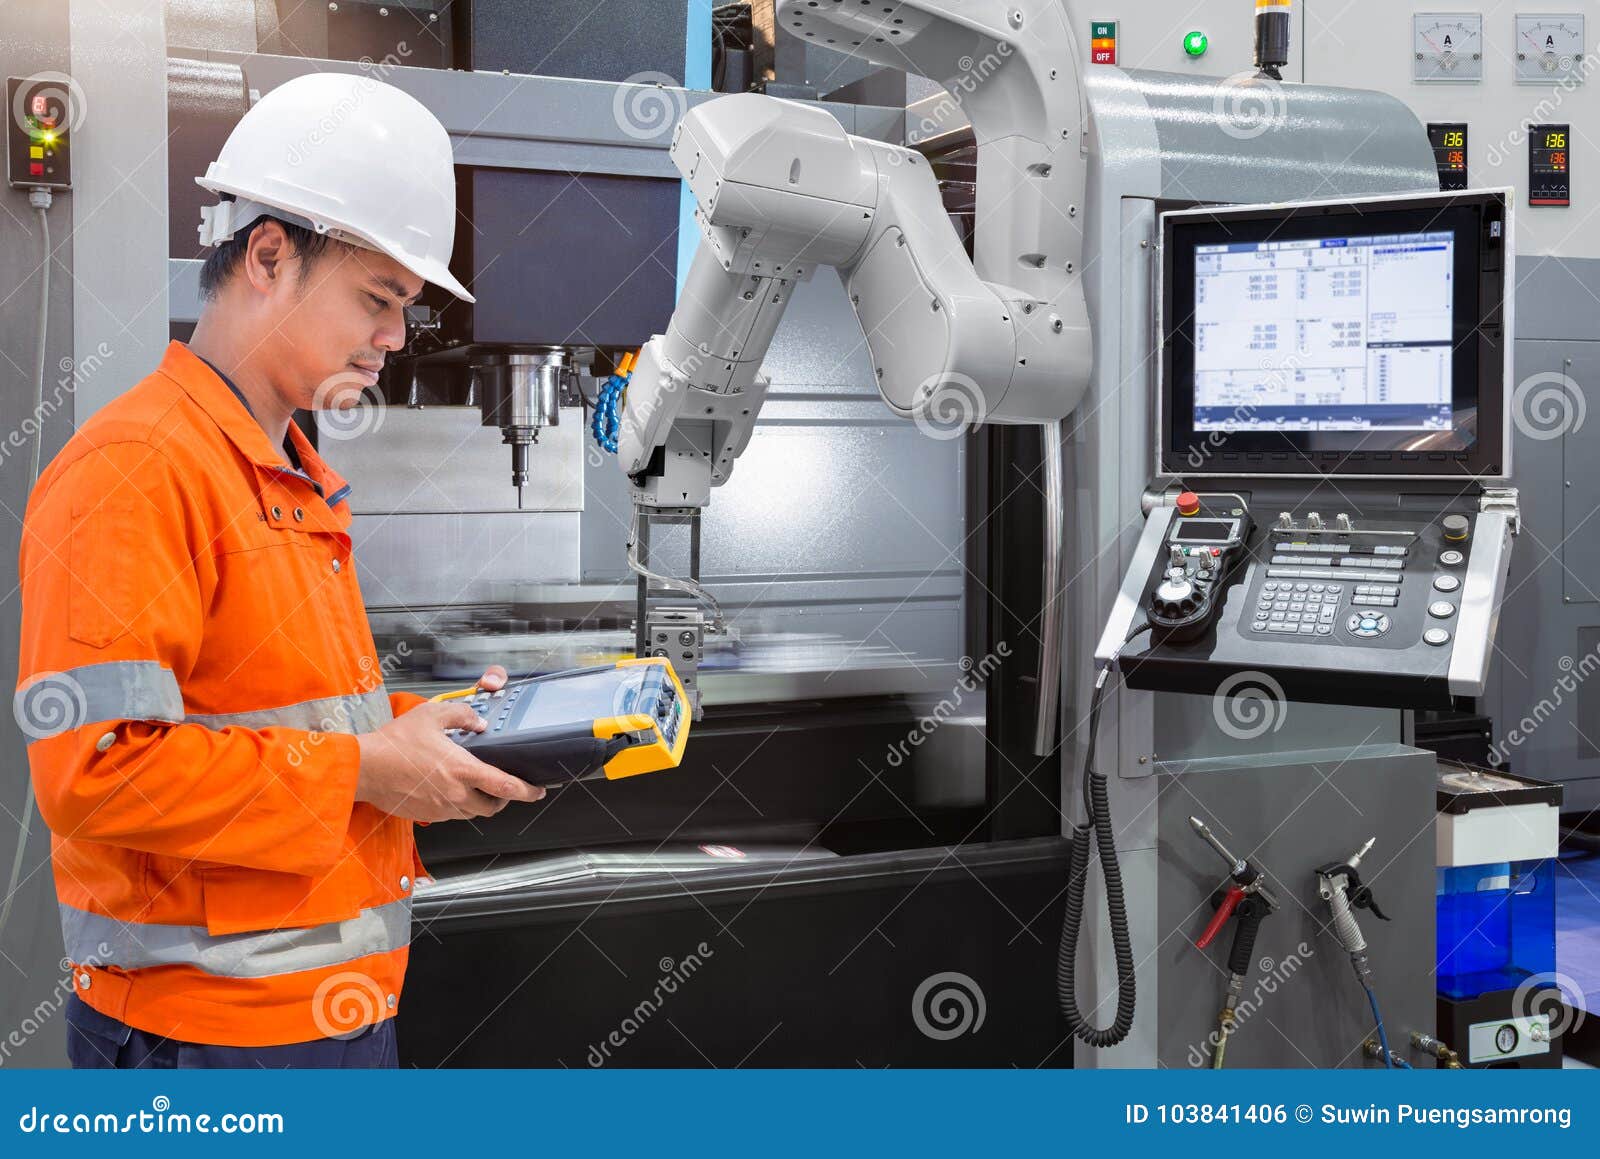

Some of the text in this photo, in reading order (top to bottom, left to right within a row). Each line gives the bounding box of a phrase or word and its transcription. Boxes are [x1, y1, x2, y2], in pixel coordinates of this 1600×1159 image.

[1097, 26, 1108, 35] ON
[1443, 34, 1452, 45] A
[1545, 34, 1554, 45] A
[1096, 52, 1111, 61] OFF
[1443, 132, 1464, 147] 136
[1545, 133, 1565, 148] 136
[1448, 151, 1464, 163] 136
[1549, 152, 1566, 164] 136
